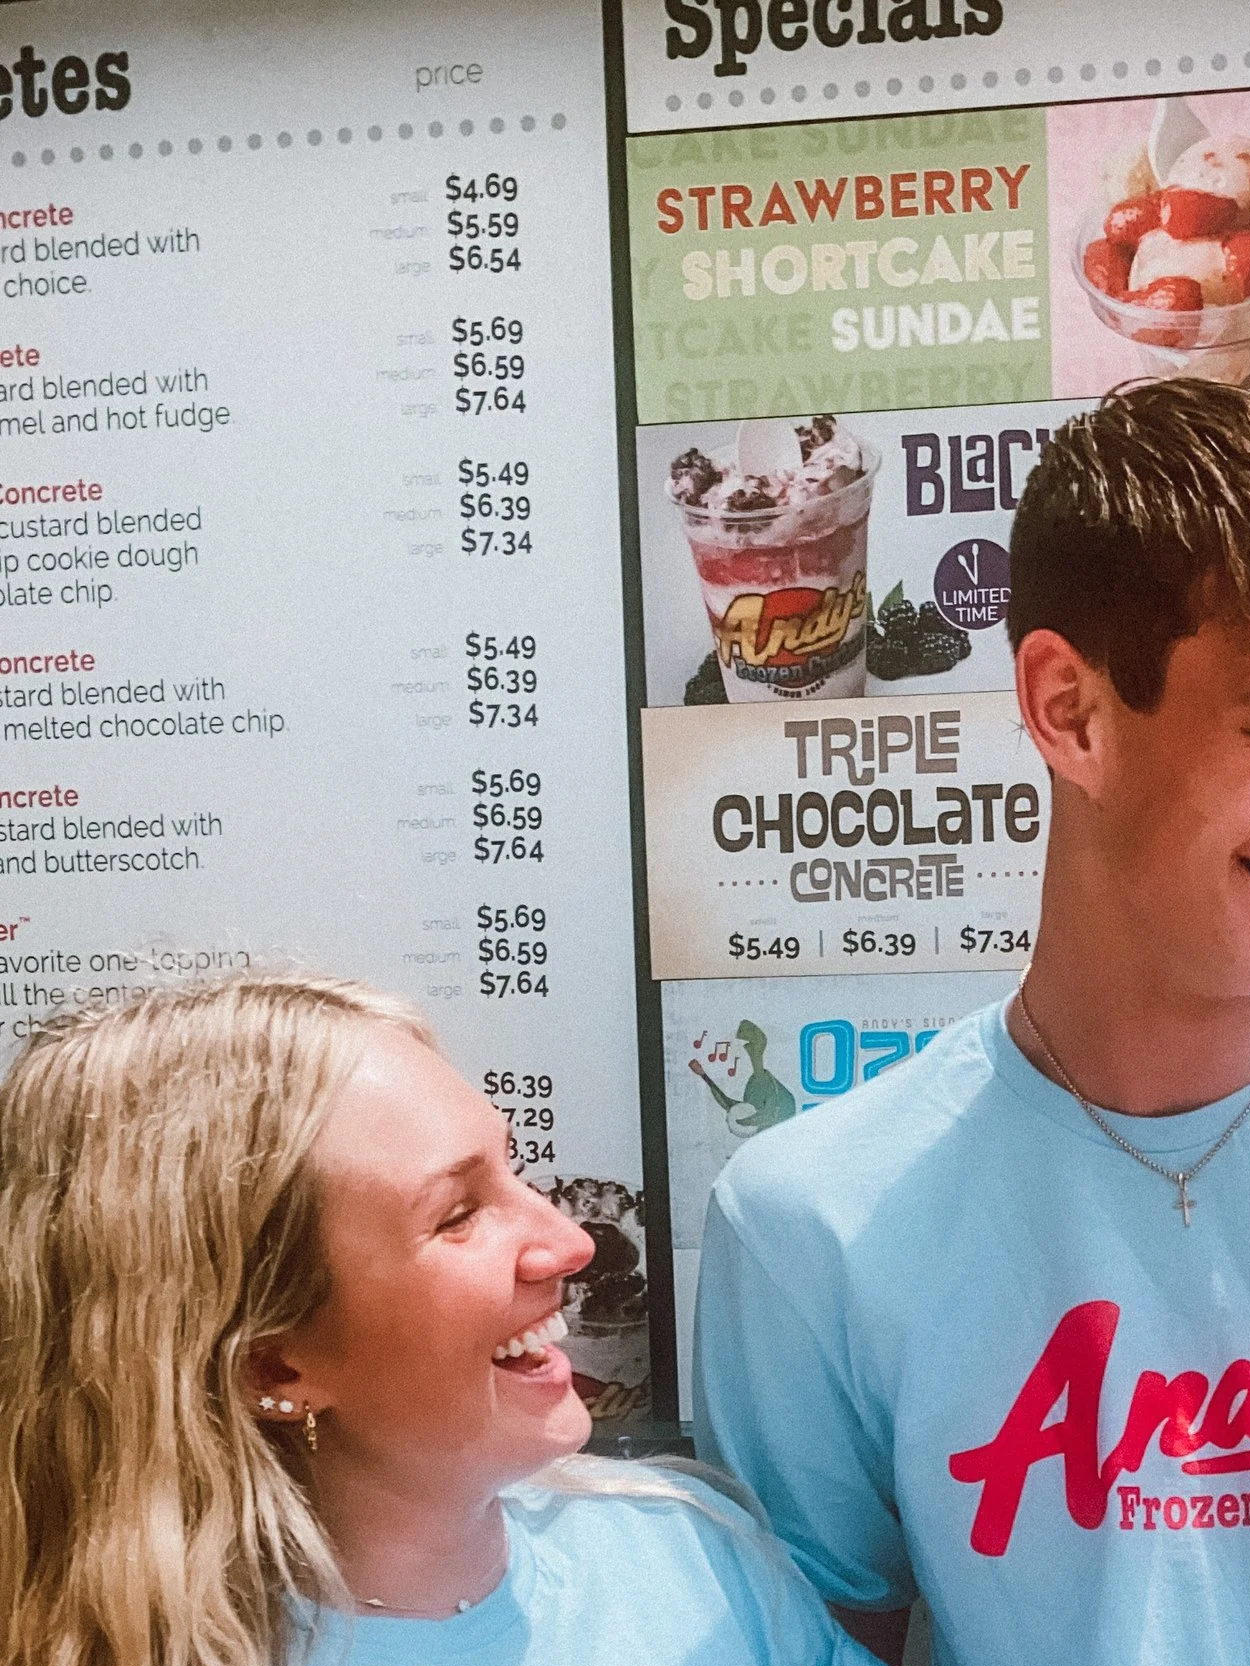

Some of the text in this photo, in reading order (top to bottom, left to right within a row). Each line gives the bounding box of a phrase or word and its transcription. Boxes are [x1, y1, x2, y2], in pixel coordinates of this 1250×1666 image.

[415, 60, 484, 93] price
[446, 173, 518, 203] $4.69
[657, 165, 1032, 235] STRAWBERRY
[448, 209, 519, 239] $5.59
[34, 231, 139, 262] blended
[147, 227, 200, 254] with
[449, 245, 521, 273] $6.54
[682, 230, 1035, 302] SHORTCAKE
[3, 271, 92, 298] choice.
[452, 316, 523, 346] $5.69
[832, 297, 1041, 353] SUNDAE
[454, 351, 524, 380] $6.59
[456, 386, 526, 415] $7.64
[52, 407, 98, 434] and
[107, 406, 148, 430] hot
[155, 402, 235, 433] fudge.
[97, 506, 202, 535] blended
[27, 545, 109, 572] cookie
[117, 540, 198, 572] dough
[60, 578, 117, 609] chip.
[955, 606, 998, 622] TIME
[61, 677, 225, 706] blended with
[4, 708, 290, 741] melted chocolate chip.
[44, 846, 205, 873] butterscotch.
[729, 925, 1031, 960] $5.49 $6.39 $7.34
[24, 983, 64, 1006] the
[484, 1070, 552, 1098] $6.39
